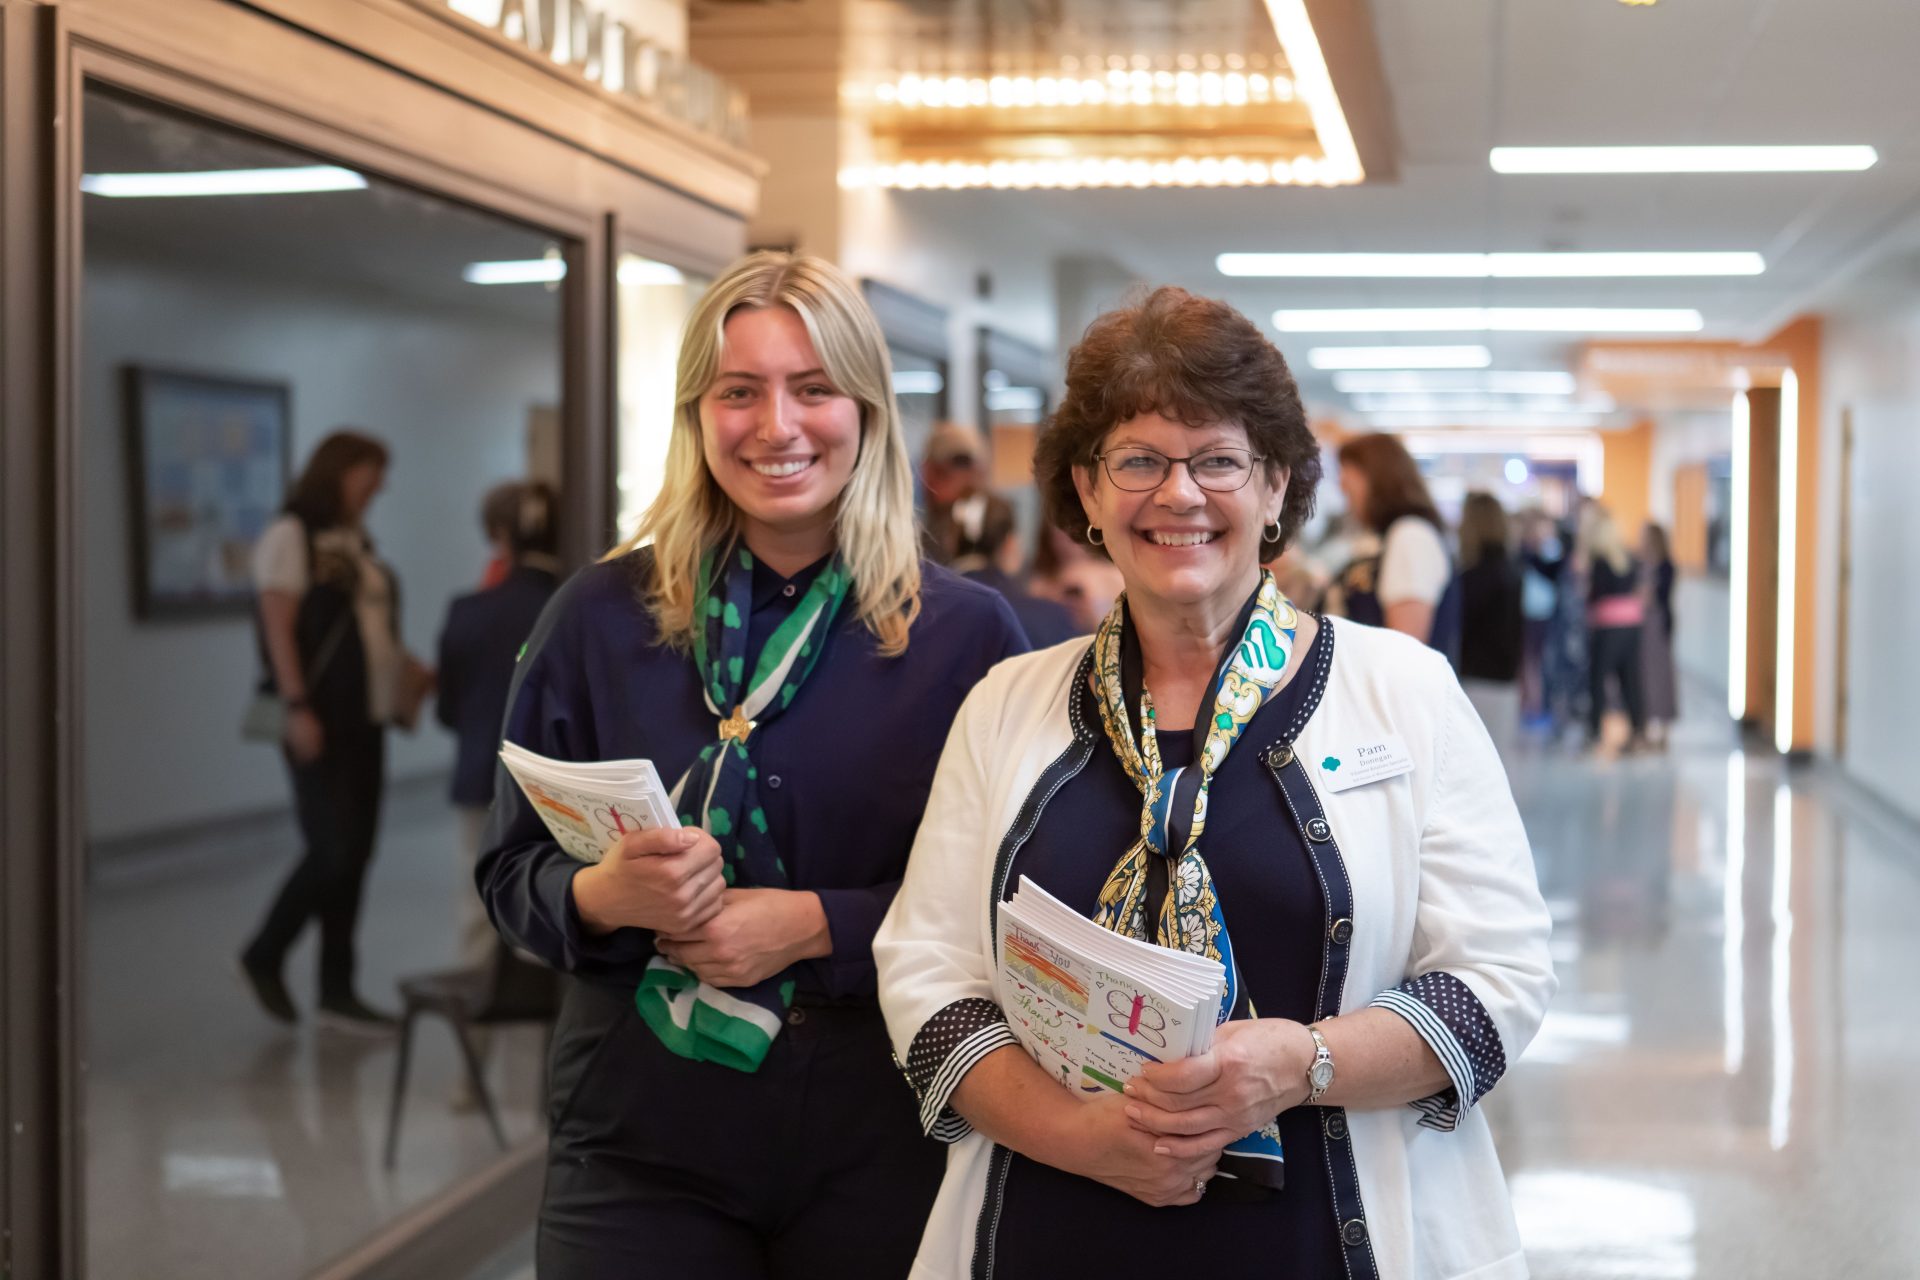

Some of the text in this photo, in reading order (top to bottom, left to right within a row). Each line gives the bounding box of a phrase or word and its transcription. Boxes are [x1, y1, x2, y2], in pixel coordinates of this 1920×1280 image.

[1356, 744, 1386, 757] Pam
[1359, 754, 1392, 767] Donegan
[1013, 925, 1040, 951] Thank
[1096, 971, 1133, 991] Thank
